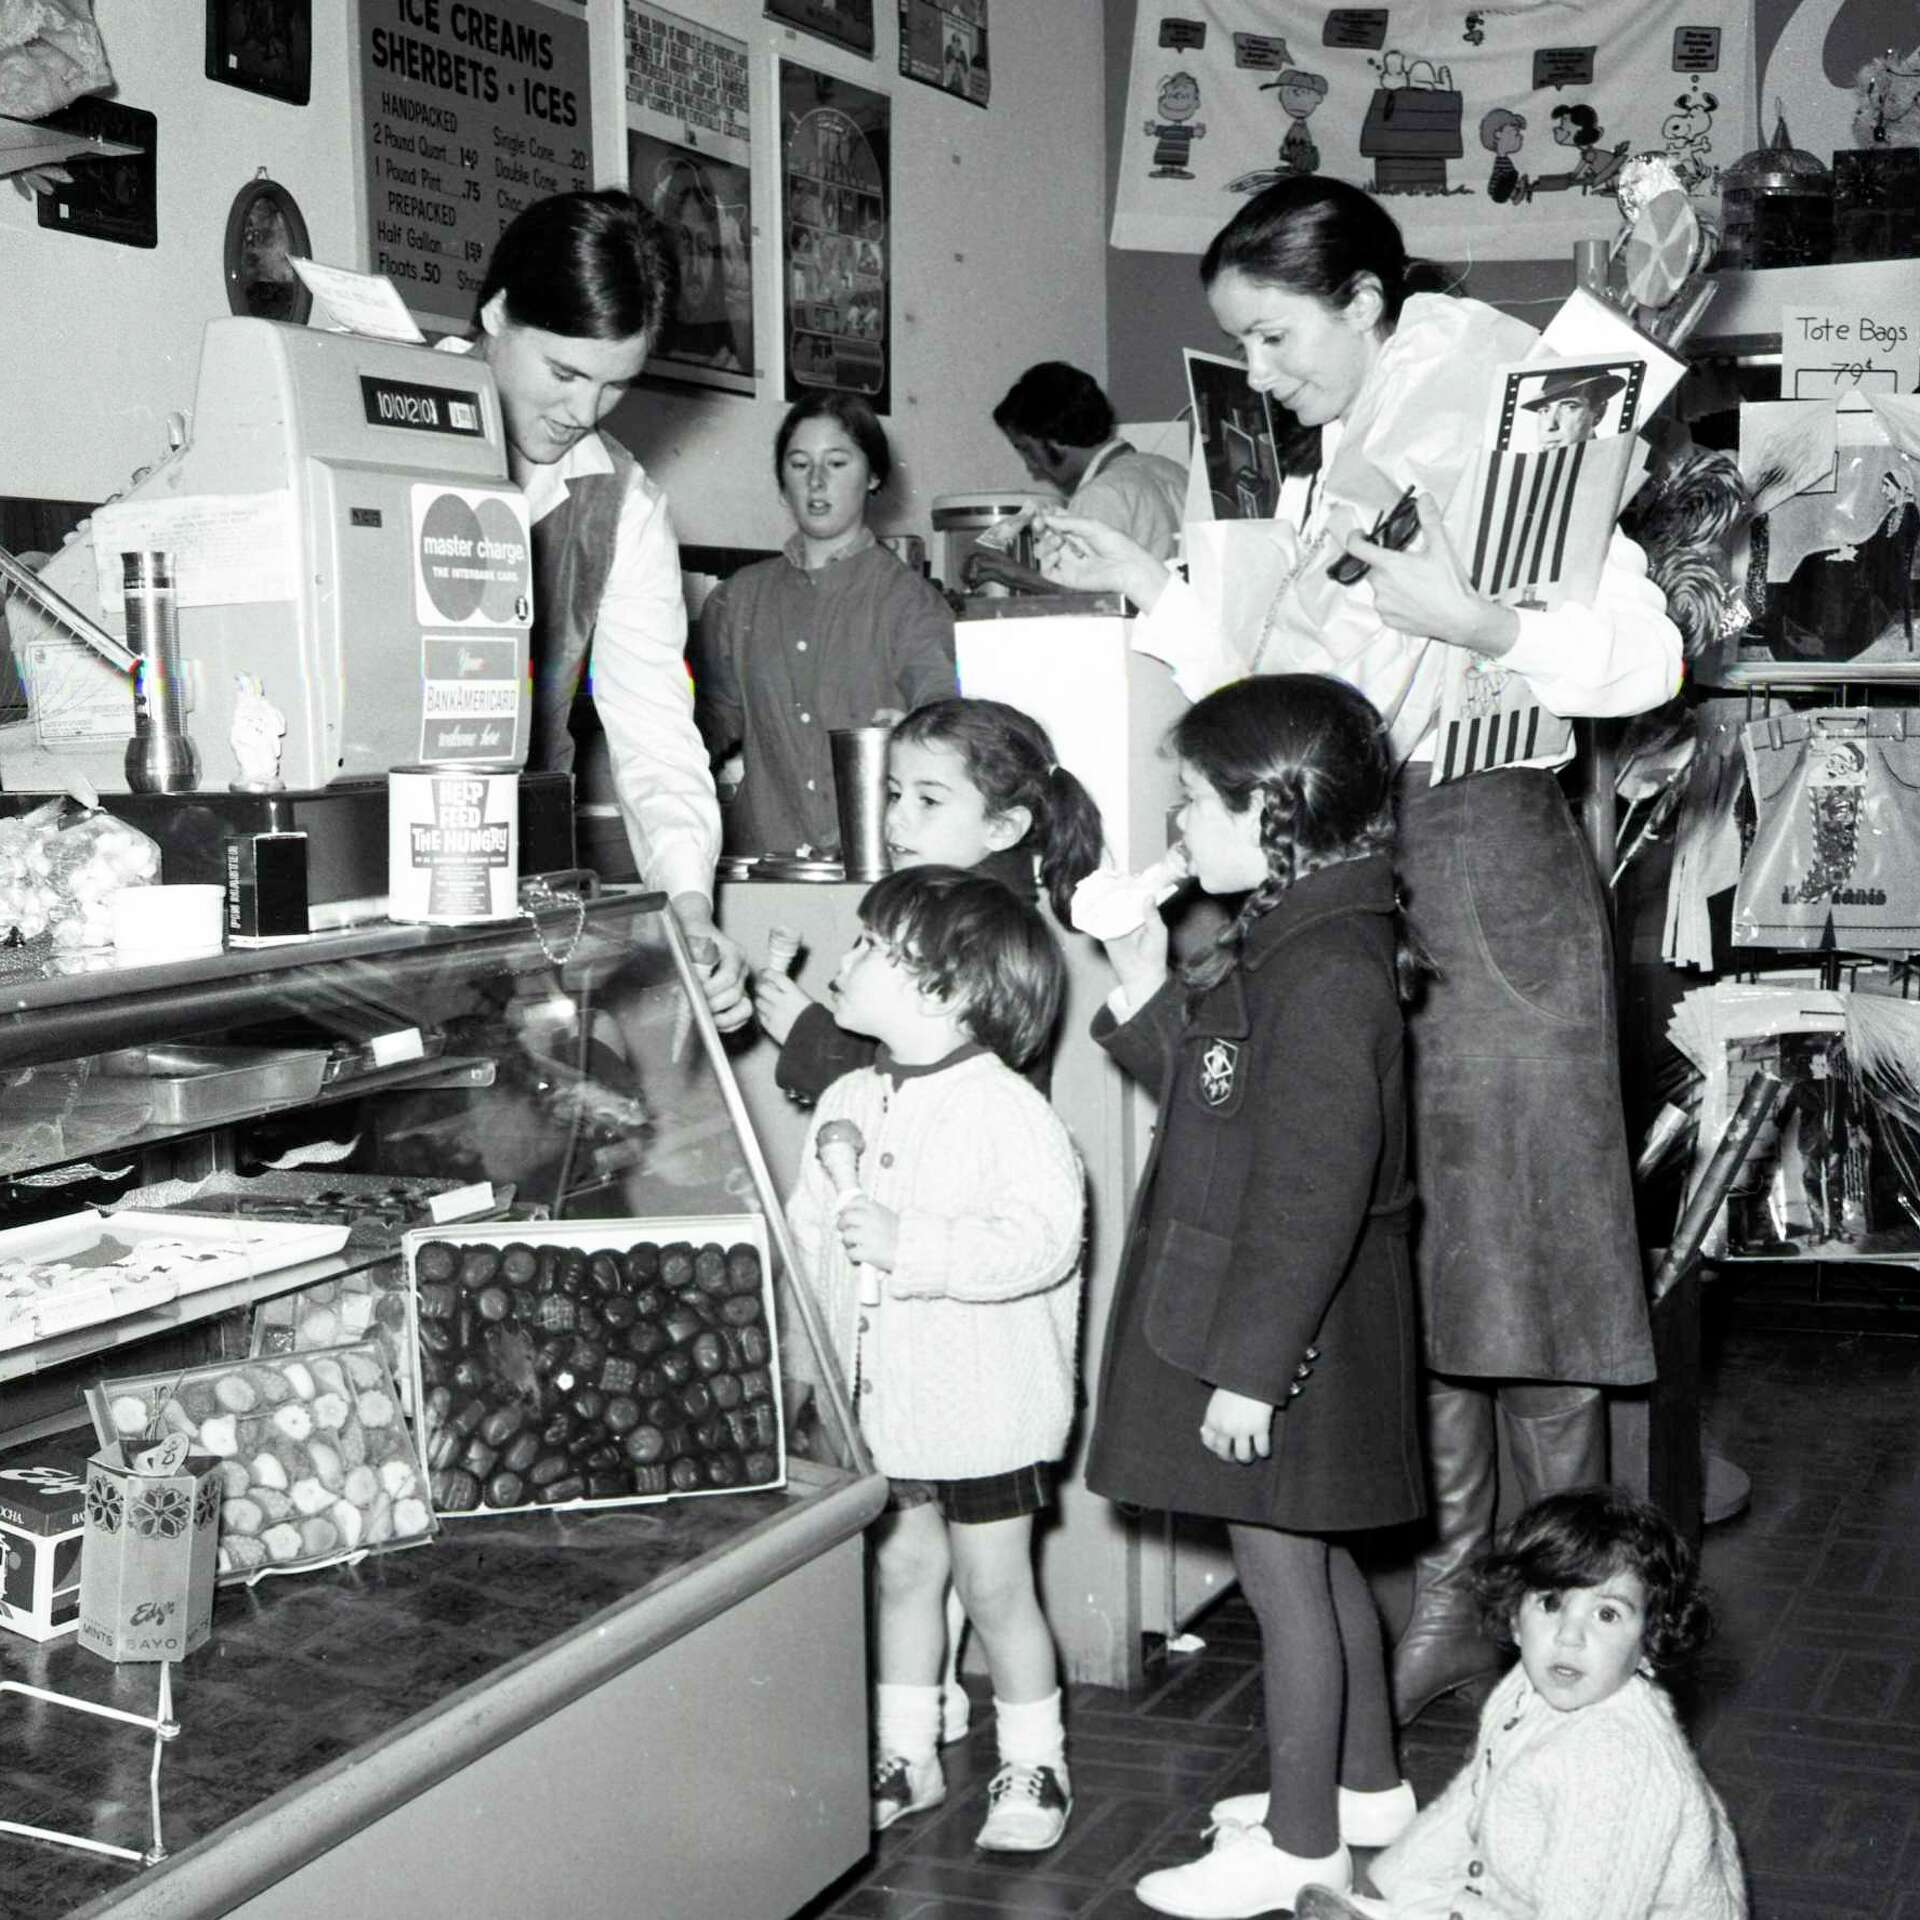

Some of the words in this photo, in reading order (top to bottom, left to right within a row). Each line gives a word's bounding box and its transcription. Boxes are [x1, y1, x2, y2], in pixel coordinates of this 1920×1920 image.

[399, 0, 440, 35] ICE
[451, 4, 554, 71] CREAMS
[372, 27, 499, 103] SHERBETS
[523, 78, 577, 127] ICES
[382, 91, 457, 133] HANDPACKED
[373, 122, 382, 144] 2
[384, 124, 415, 153] Pound
[493, 126, 526, 157] Single
[529, 137, 555, 159] Cone
[375, 155, 380, 176] 1
[386, 158, 416, 185] Pound
[421, 168, 441, 192] Pint
[496, 157, 529, 185] Double
[533, 168, 557, 191] Cone
[388, 191, 456, 227] PREPACKED
[377, 219, 402, 245] Half
[407, 227, 442, 254] Gallon
[379, 252, 417, 280] Floats
[421, 262, 441, 285] .50
[1795, 316, 1850, 342] Tote
[1860, 317, 1908, 353] Bags
[423, 534, 473, 558] master
[476, 536, 525, 564] charge
[439, 781, 484, 805] HELP
[439, 806, 482, 829] FEED
[412, 828, 441, 852] THE
[444, 827, 508, 853] HUNGRY
